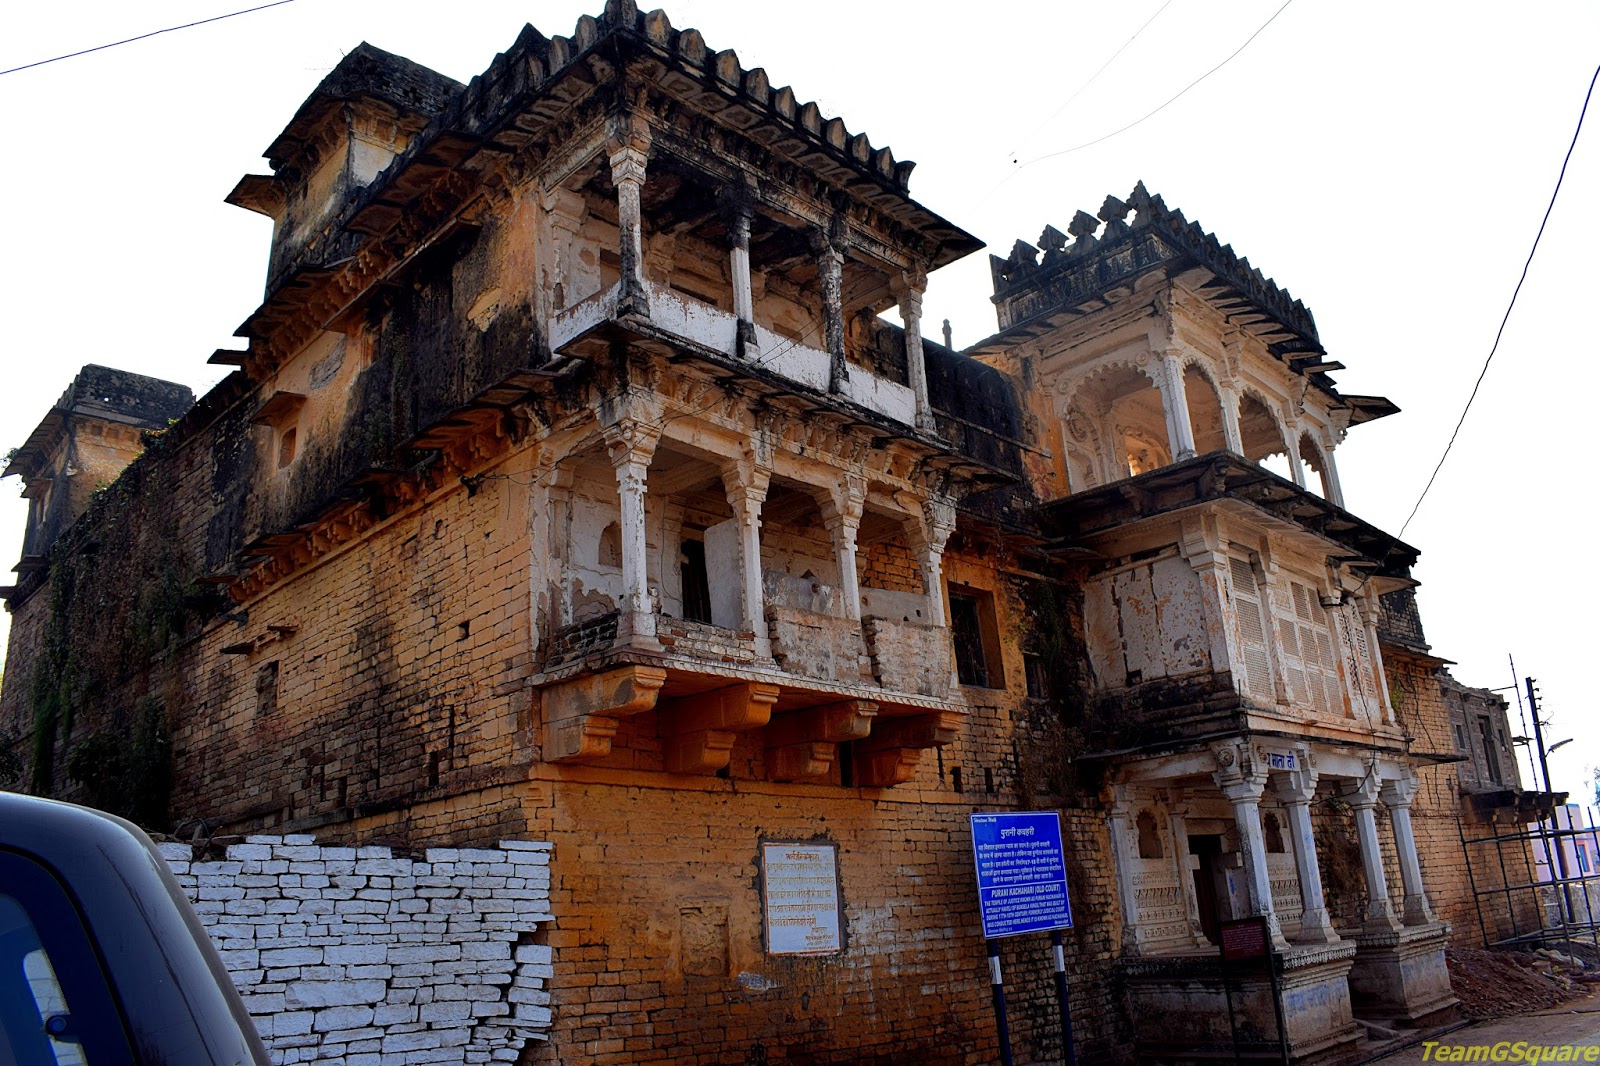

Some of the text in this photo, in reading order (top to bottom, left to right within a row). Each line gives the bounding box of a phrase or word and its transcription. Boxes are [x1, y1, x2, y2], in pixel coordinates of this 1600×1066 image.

[1286, 750, 1295, 770] दी
[1001, 826, 1034, 839] पुरानी कचहरी
[992, 884, 1060, 897] PURANI KACHAHARI (OLD COURT)
